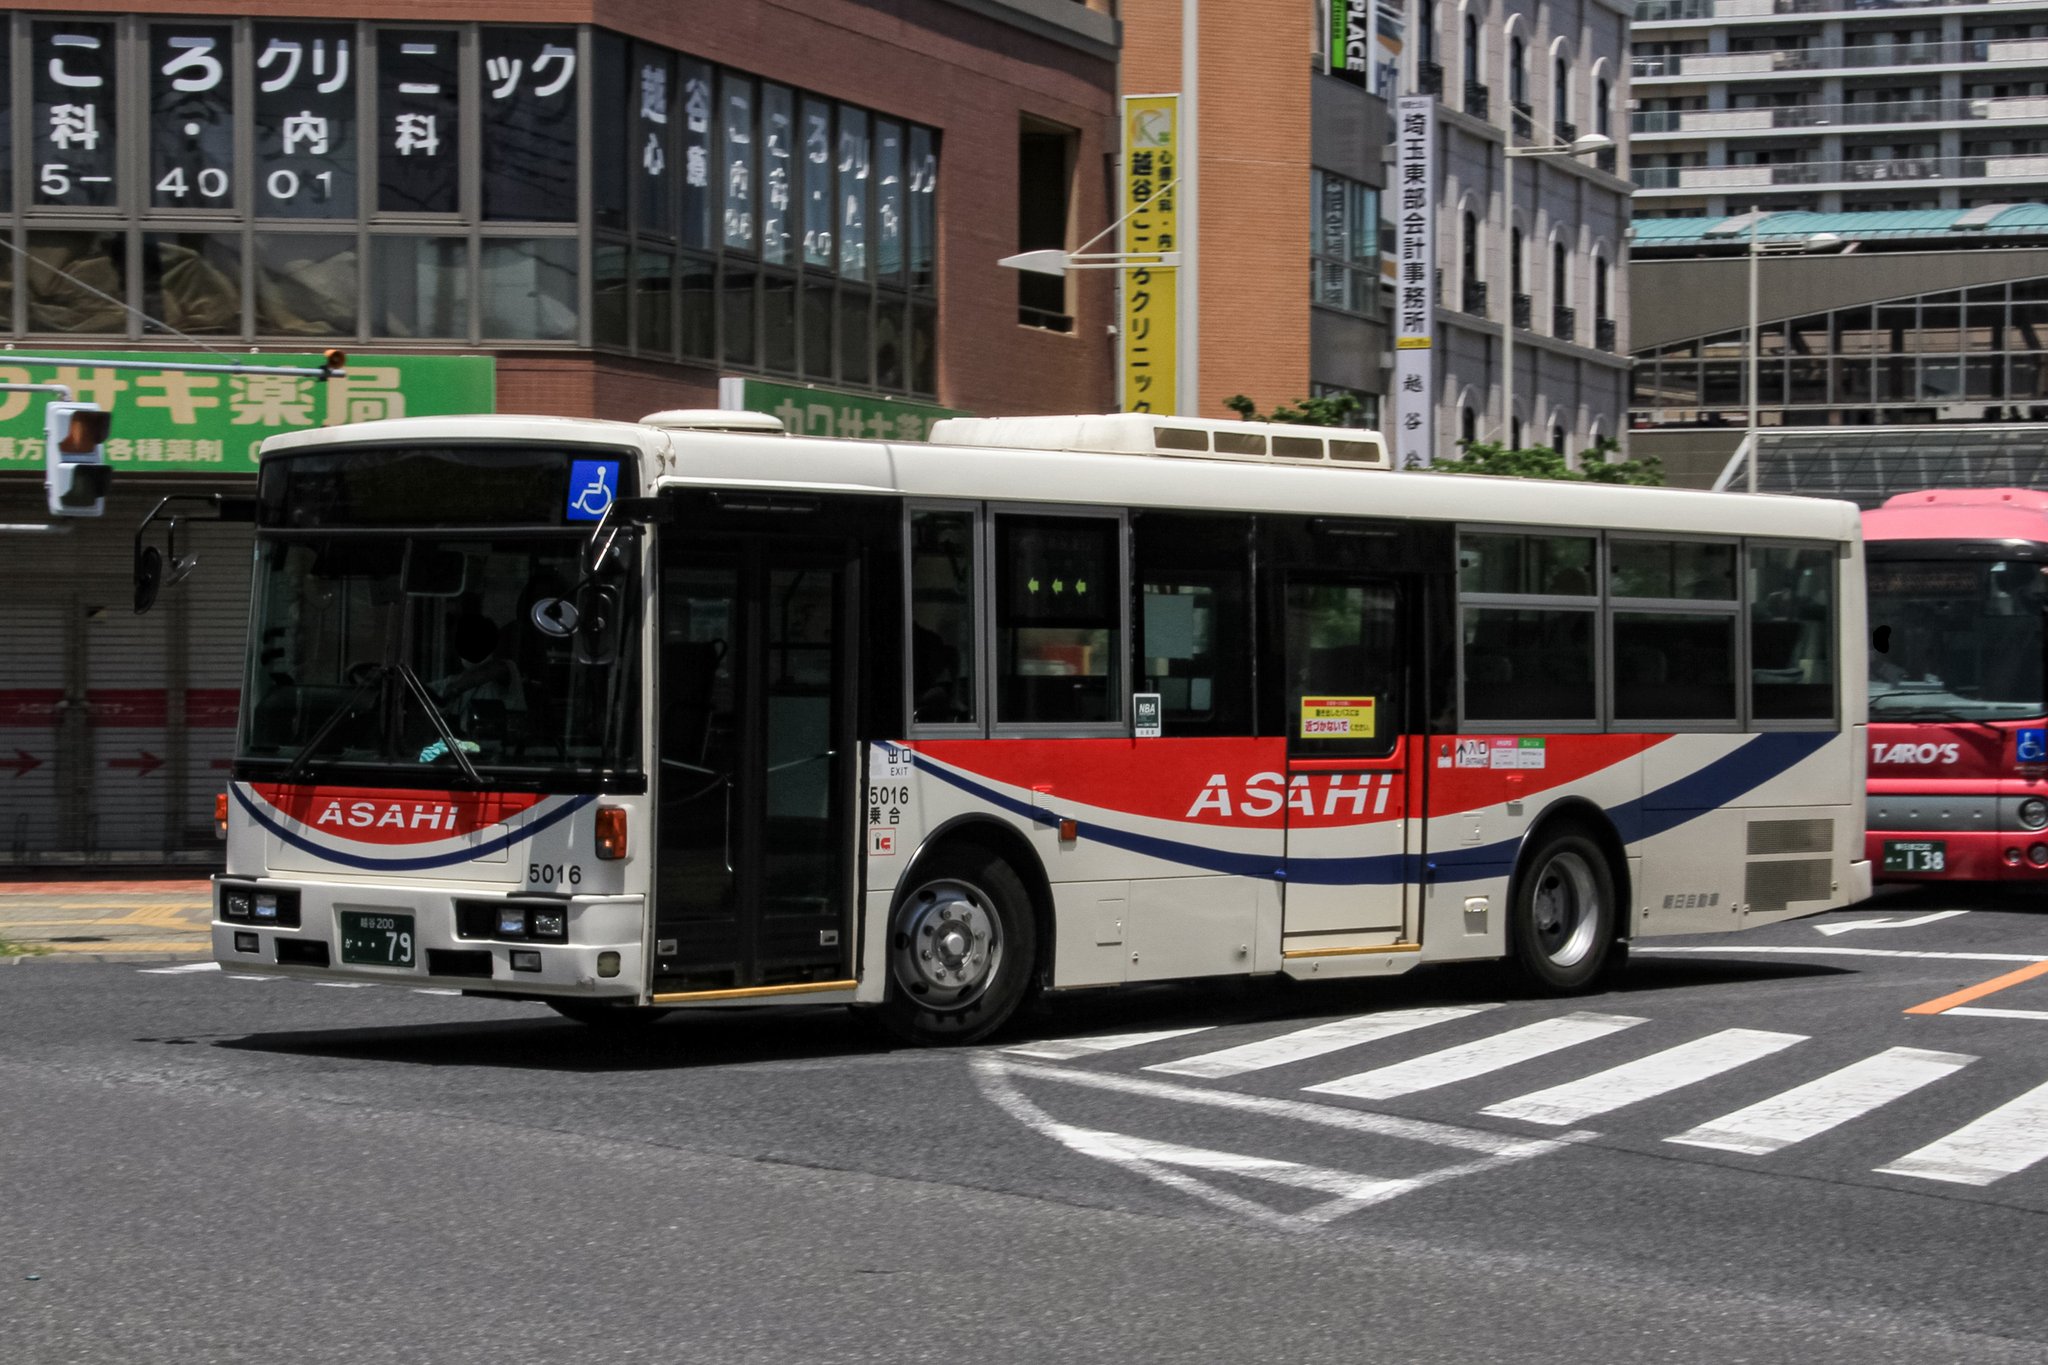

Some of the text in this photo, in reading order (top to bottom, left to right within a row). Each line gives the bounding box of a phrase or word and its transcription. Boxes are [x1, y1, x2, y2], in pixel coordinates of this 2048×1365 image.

[774, 398, 942, 441] カワサキ薬
[888, 748, 912, 765] 出口
[1871, 743, 1960, 765] TARO'S
[890, 767, 908, 777] EXIT
[870, 786, 909, 805] 5016
[1185, 771, 1394, 818] ASAHI
[316, 801, 459, 830] ASAHI
[869, 806, 901, 825] 乗合
[529, 863, 582, 885] 5016
